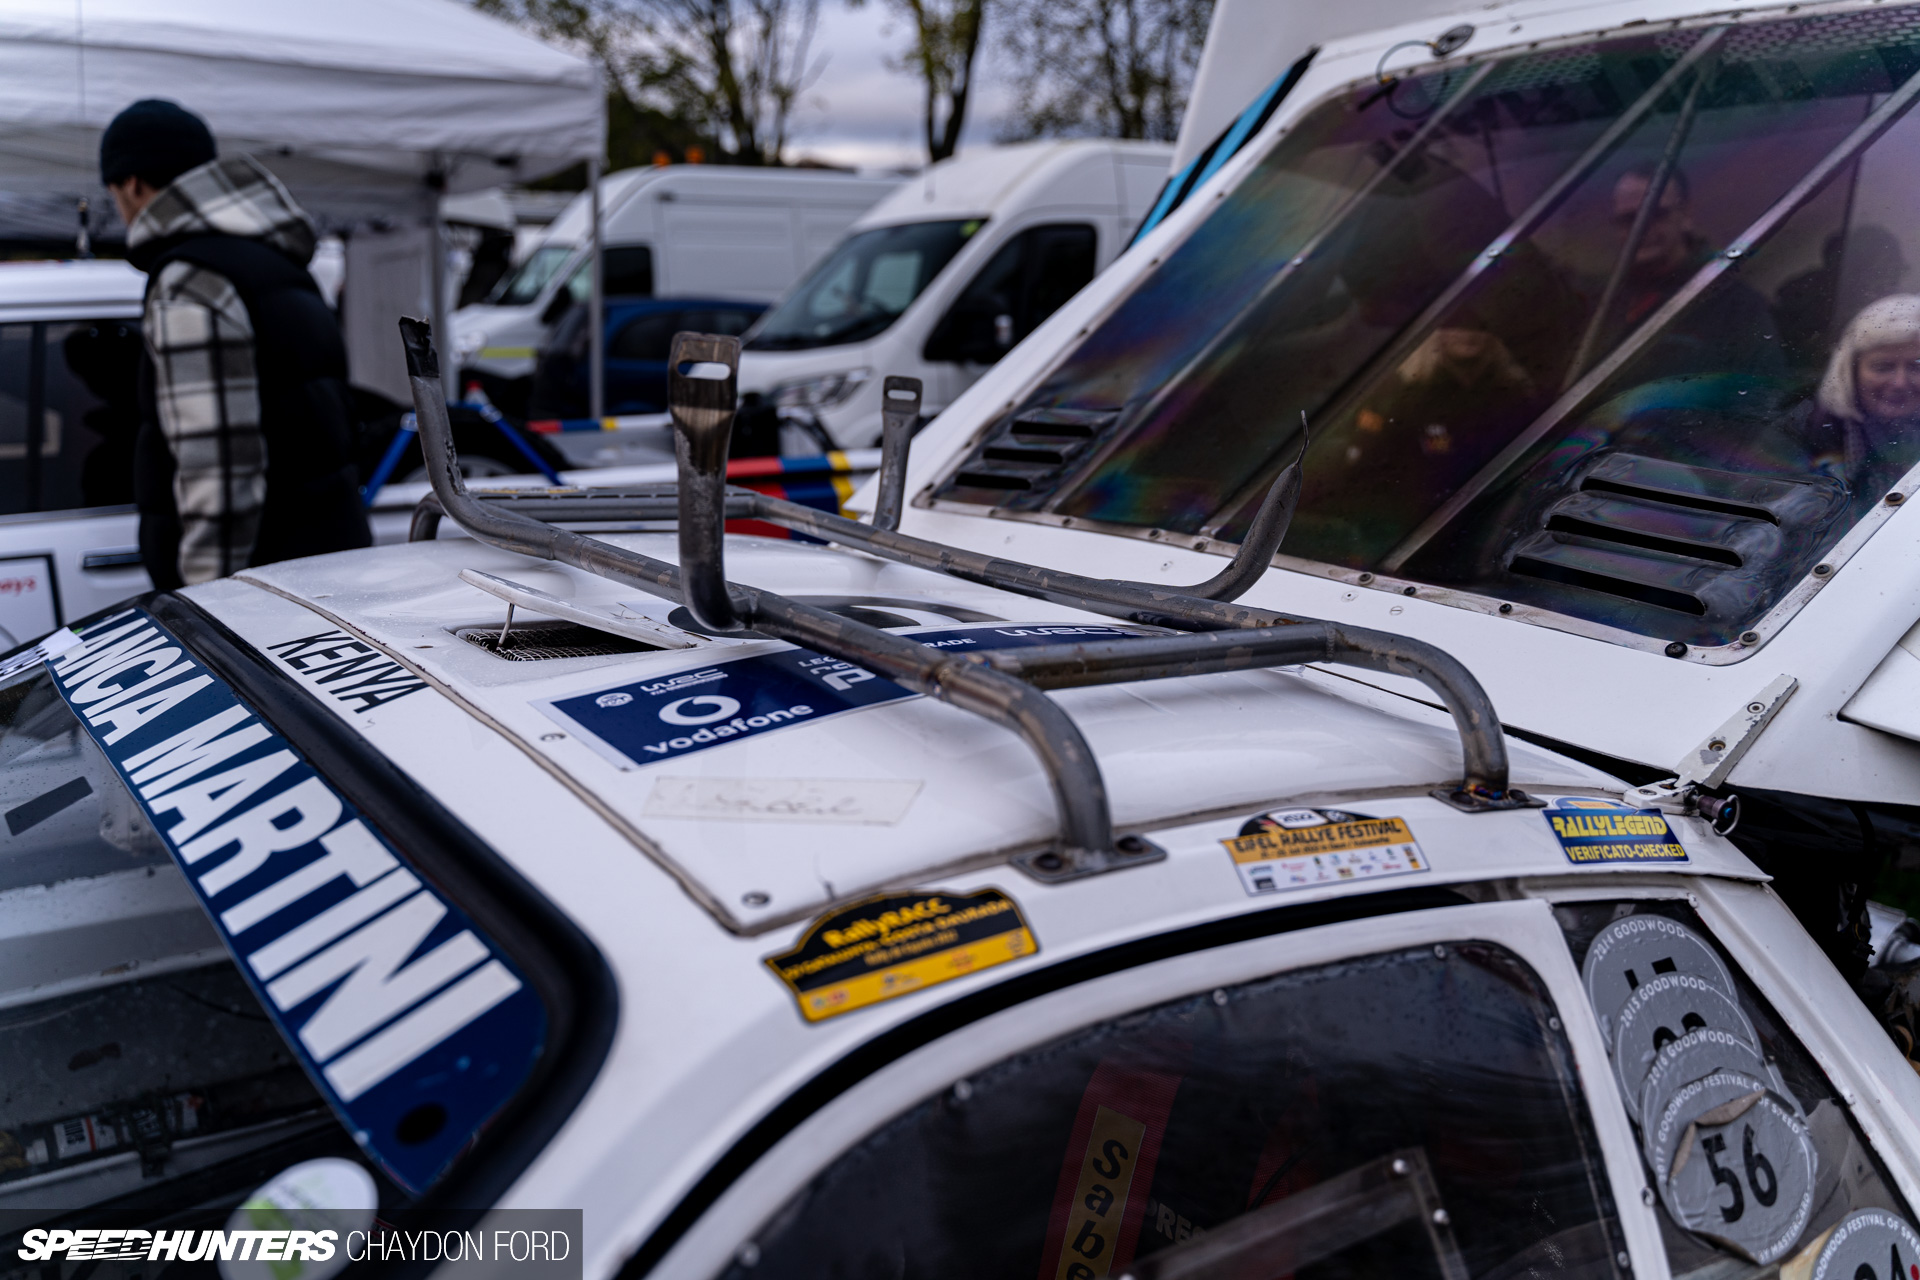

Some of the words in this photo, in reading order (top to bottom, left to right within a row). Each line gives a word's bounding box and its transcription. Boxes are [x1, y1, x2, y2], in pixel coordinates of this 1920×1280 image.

[921, 638, 976, 648] RADE
[266, 630, 431, 714] KENYA
[643, 704, 815, 754] vodafone
[1234, 835, 1279, 853] EIFEL
[1280, 827, 1336, 847] RALLYE
[1338, 819, 1403, 840] FESTIVAL
[1552, 815, 1668, 838] RALLYLEGEND
[1565, 843, 1685, 861] VERIFICATO-CHECKED
[121, 704, 523, 1103] MARTINI
[1613, 919, 1686, 939] GOODWOOD
[1620, 996, 1641, 1028] 2015
[1638, 975, 1707, 1001] GOODWOOD
[1648, 1054, 1669, 1086] 2016
[1666, 1030, 1735, 1058] GOODWOOD
[1657, 1081, 1702, 1143] GOODWOOD
[1703, 1073, 1750, 1089] FESTIVAL
[1702, 1122, 1778, 1223] 56
[1846, 1214, 1886, 1234] FESTIVAL
[1886, 1217, 1899, 1231] OF
[1901, 1226, 1920, 1262] SPEE
